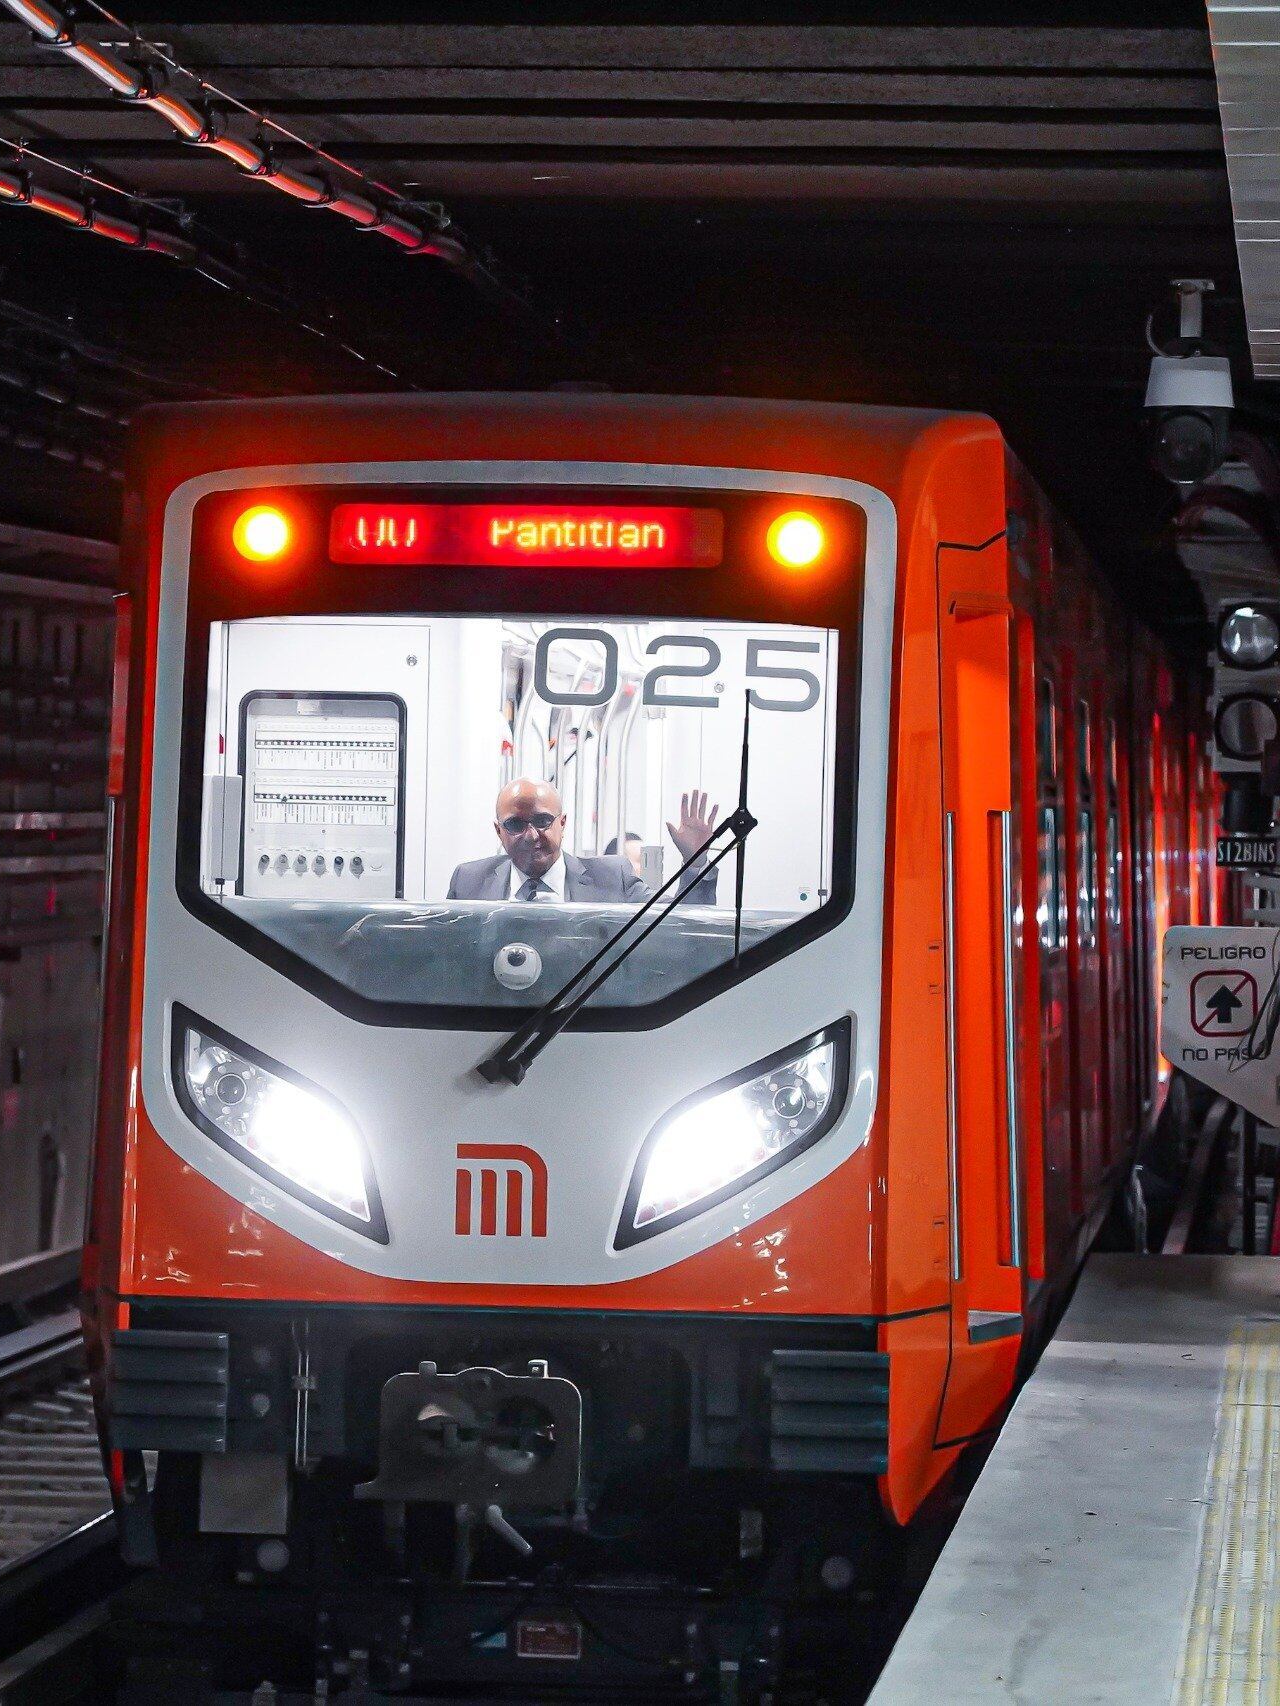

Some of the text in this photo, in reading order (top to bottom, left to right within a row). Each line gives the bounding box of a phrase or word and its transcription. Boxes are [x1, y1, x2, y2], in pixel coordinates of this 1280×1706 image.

[534, 627, 821, 713] 025
[1181, 946, 1266, 960] PELIGRO
[1182, 1048, 1209, 1061] NO
